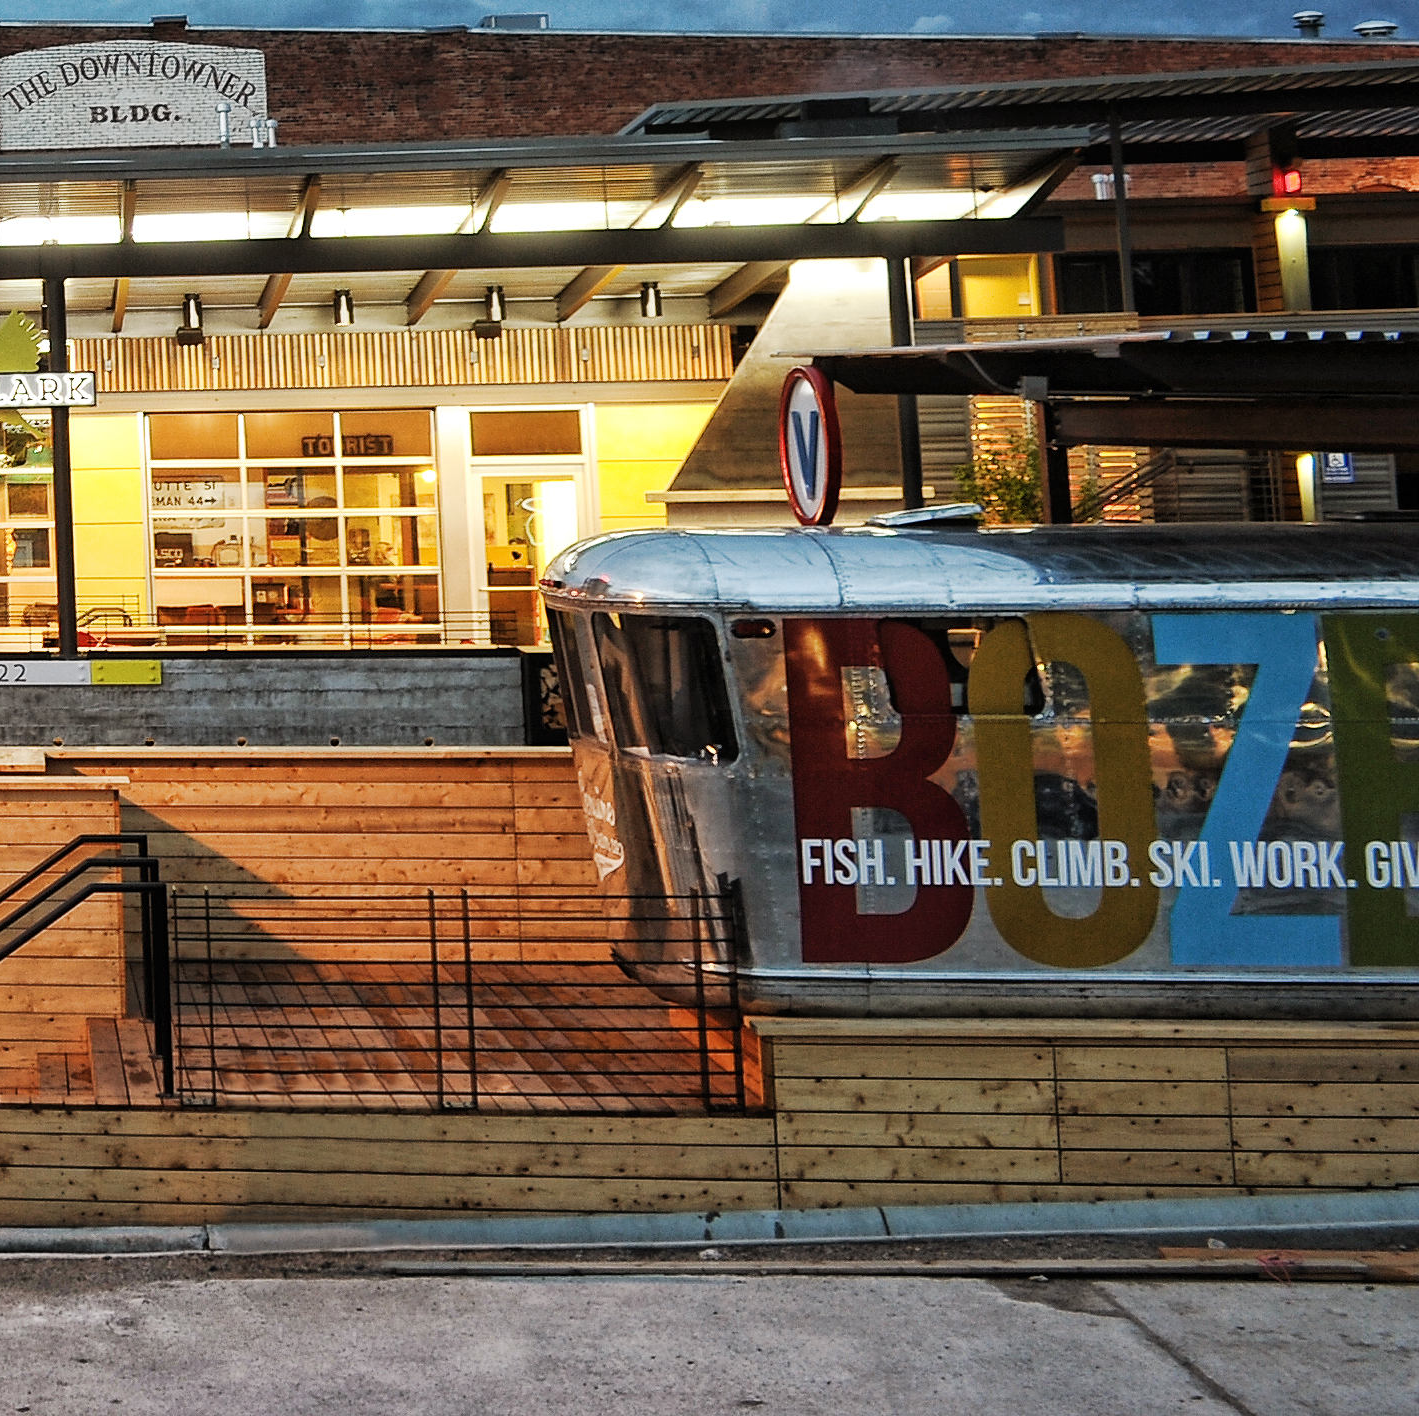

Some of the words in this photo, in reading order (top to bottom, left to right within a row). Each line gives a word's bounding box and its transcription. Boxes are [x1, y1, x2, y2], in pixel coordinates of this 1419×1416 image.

[2, 69, 58, 113] THE
[58, 52, 257, 109] DOWNTOWNER
[88, 103, 181, 124] BLDG.
[303, 436, 393, 456] TORIST
[791, 410, 819, 500] V
[801, 838, 896, 885] FISH.
[905, 839, 1003, 886] HIKE.
[1011, 839, 1140, 887] CLIMB.
[1148, 840, 1222, 887] SKI.
[1227, 841, 1358, 888] WORK.
